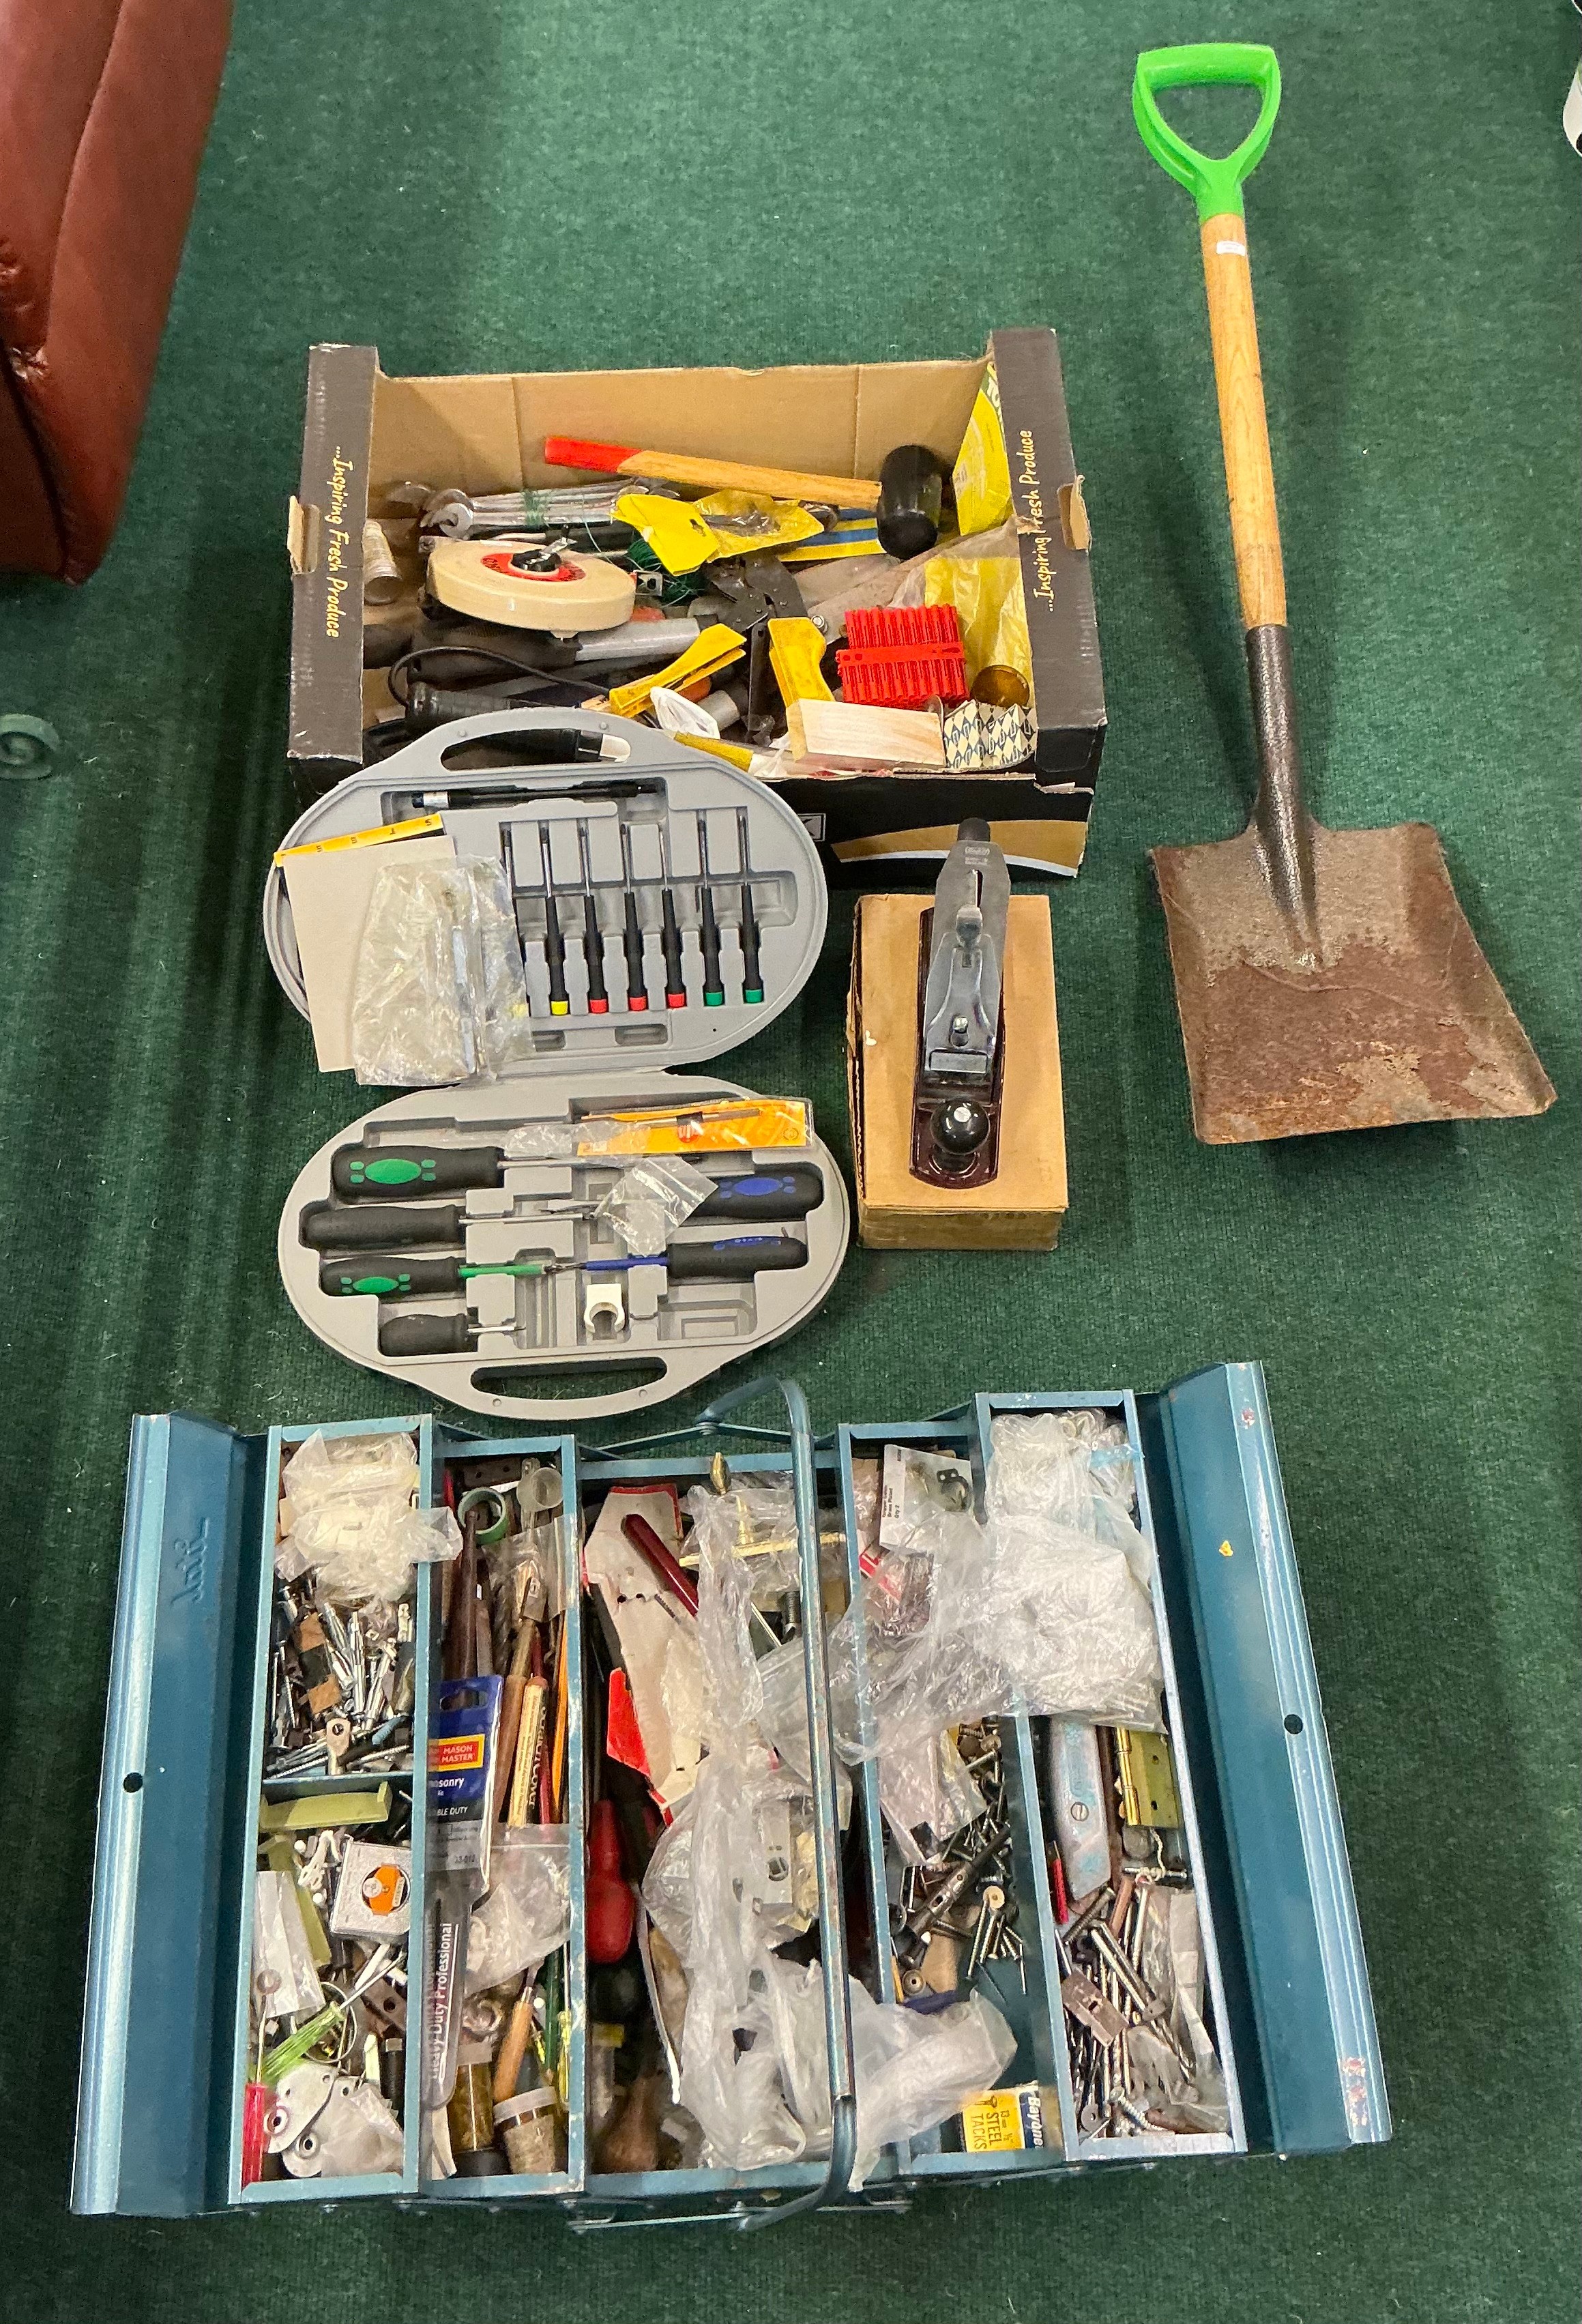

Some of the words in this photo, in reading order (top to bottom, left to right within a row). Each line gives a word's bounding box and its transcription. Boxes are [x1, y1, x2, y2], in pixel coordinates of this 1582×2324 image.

[1016, 430, 1040, 485] Produce
[327, 528, 350, 572] Fresh
[326, 577, 349, 638] Produce
[441, 1753, 474, 1763] MASTER
[443, 1744, 473, 1755] MASON
[450, 1805, 468, 1816] DUTY
[434, 1923, 452, 1999] Professional
[433, 2002, 448, 2034] Duty
[971, 2113, 987, 2149] TACKS
[986, 2112, 1003, 2146] STEEL
[1027, 2096, 1044, 2149] Bayone
